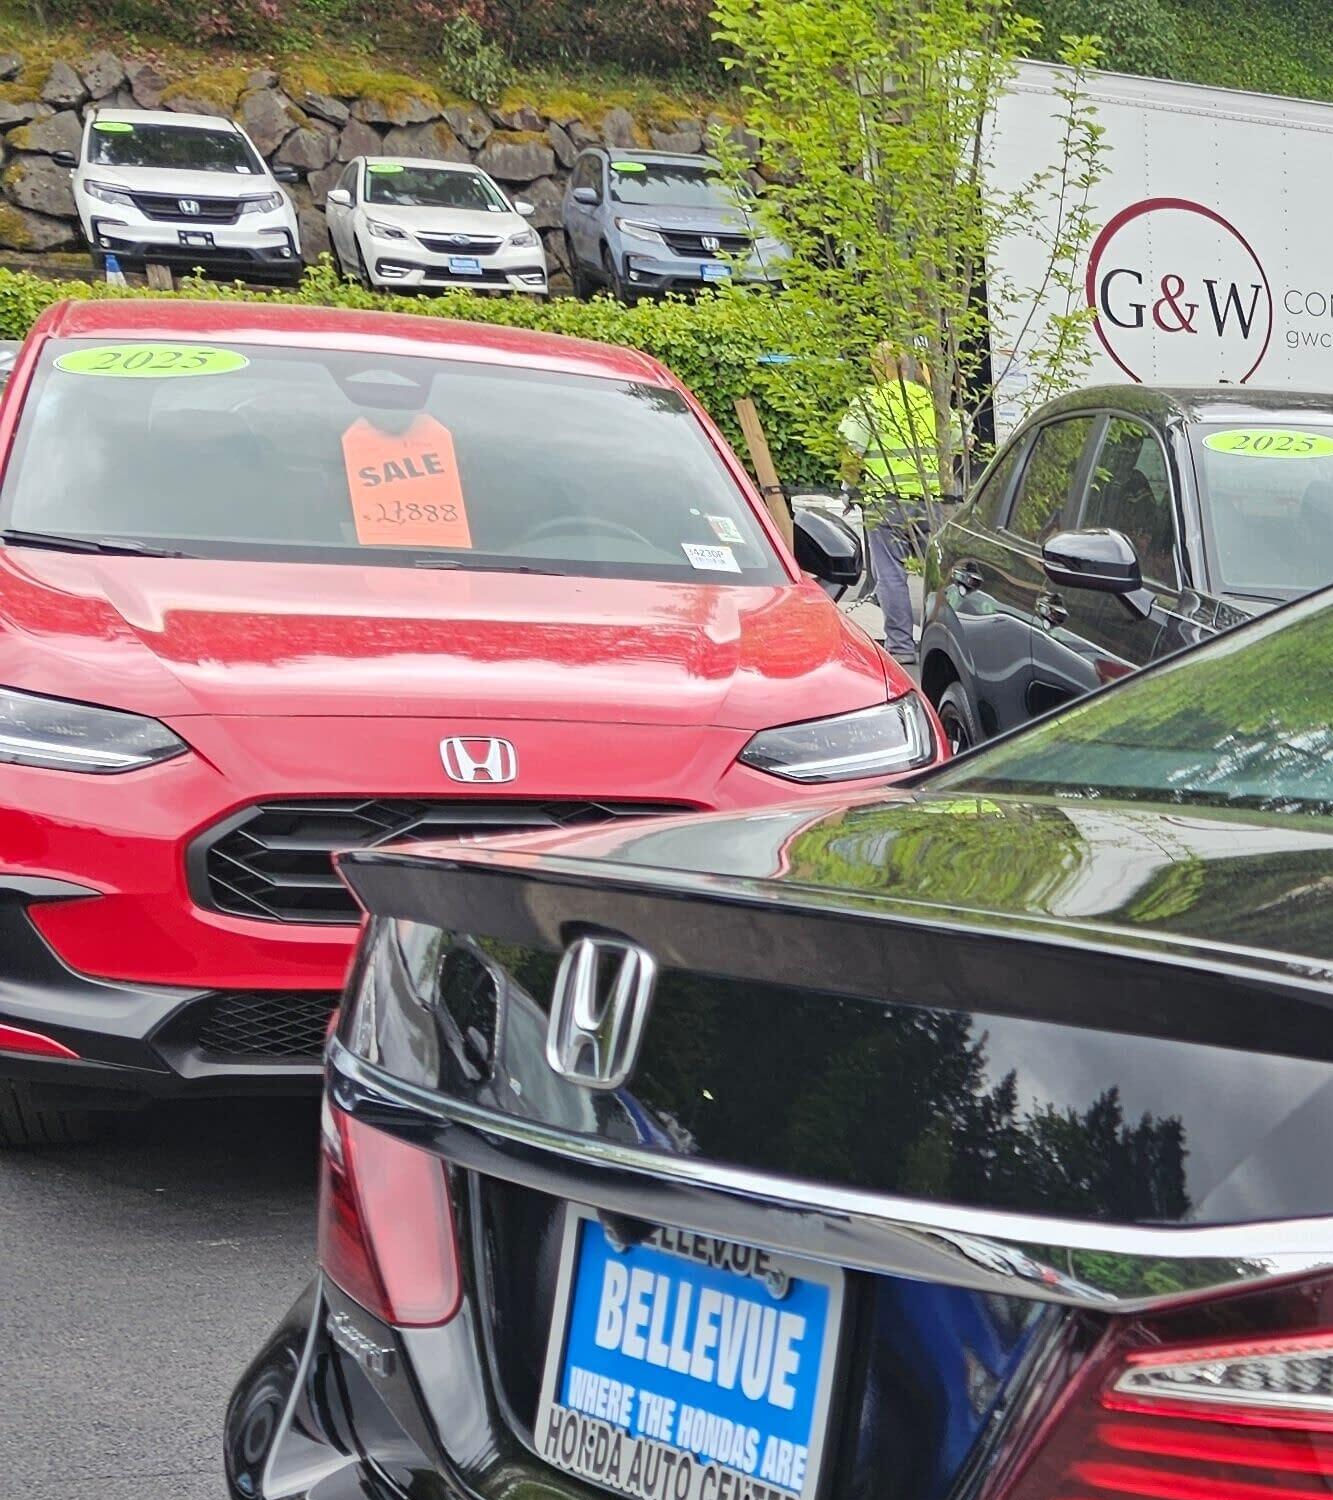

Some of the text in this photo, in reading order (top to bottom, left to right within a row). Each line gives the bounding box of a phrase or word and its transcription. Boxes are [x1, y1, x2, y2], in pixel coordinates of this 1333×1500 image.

[1100, 268, 1262, 340] G&W
[88, 350, 217, 371] 2025
[358, 452, 445, 488] SALE
[1230, 434, 1318, 452] 2025
[595, 1259, 806, 1411] BELLEVUE
[544, 1407, 622, 1484] HONDA
[567, 1365, 809, 1491] WHERE THE HONDAS ARE
